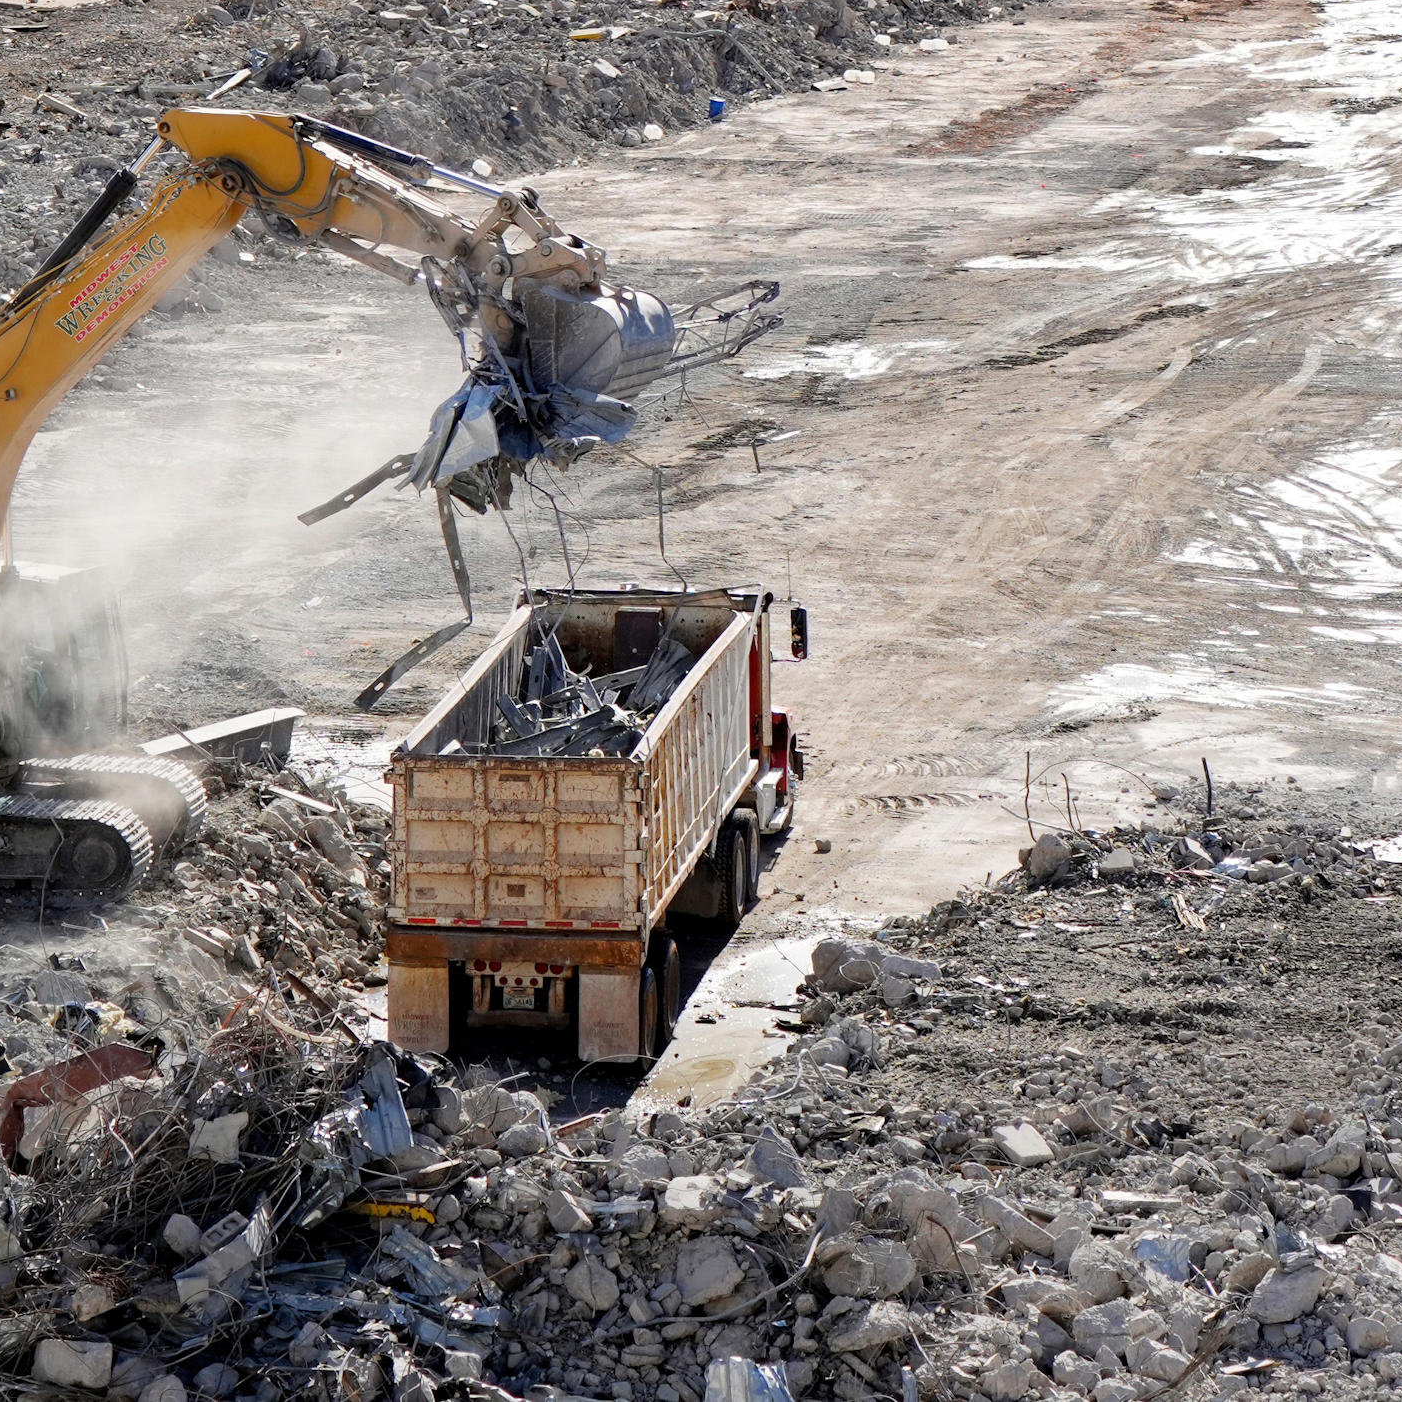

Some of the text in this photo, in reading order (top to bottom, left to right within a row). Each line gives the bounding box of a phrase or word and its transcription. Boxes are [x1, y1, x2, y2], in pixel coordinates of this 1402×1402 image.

[54, 233, 168, 337] WRECKING
[69, 242, 139, 310] MIDWEST
[75, 256, 169, 343] DEMOLITION
